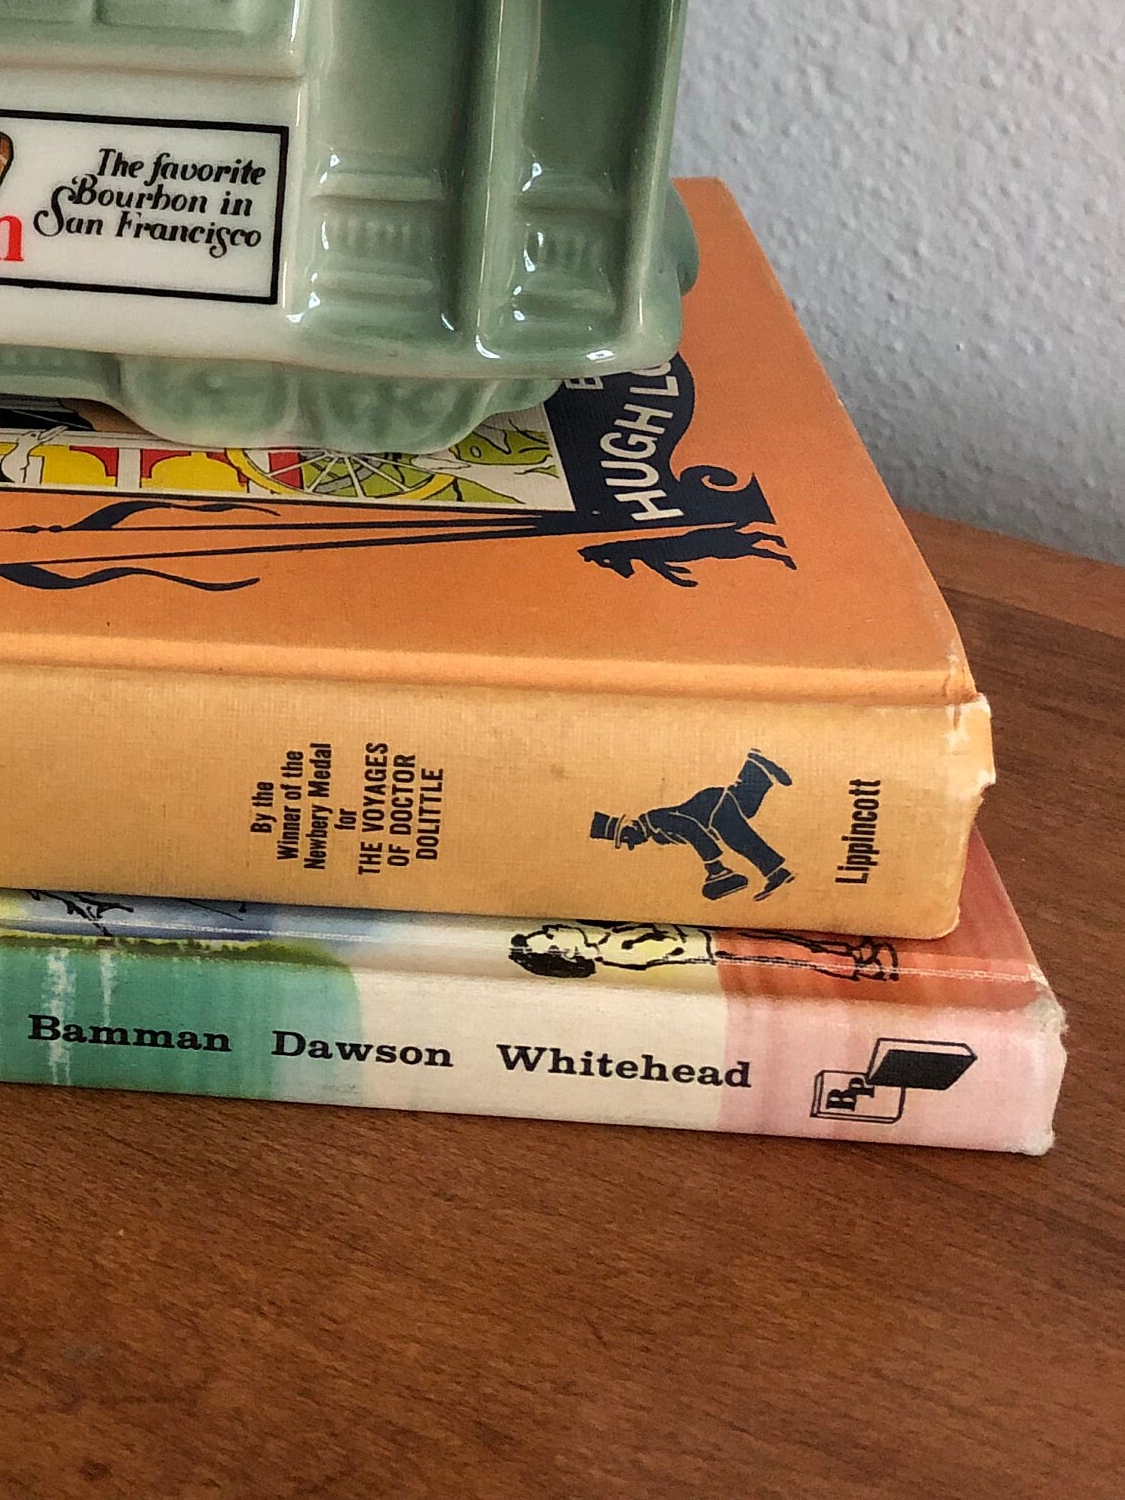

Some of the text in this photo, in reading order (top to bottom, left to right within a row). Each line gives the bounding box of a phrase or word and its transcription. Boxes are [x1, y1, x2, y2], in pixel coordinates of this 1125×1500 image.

[72, 173, 253, 216] Bourbon in
[97, 148, 266, 187] The favorite
[33, 185, 261, 258] San Francisco
[600, 403, 684, 521] HUGH
[250, 782, 277, 833] By the
[276, 750, 304, 860] Winner of the
[303, 743, 333, 870] Newbery Medal
[334, 808, 357, 830] for
[358, 742, 388, 875] THE VOYAGES
[387, 754, 415, 867] OF DOCTOR
[415, 768, 443, 860] DOLITTLE
[835, 778, 881, 884] Lippincott
[27, 1014, 231, 1054] Bamman
[271, 1030, 454, 1069] Dawson
[497, 1044, 752, 1089] Whitehead
